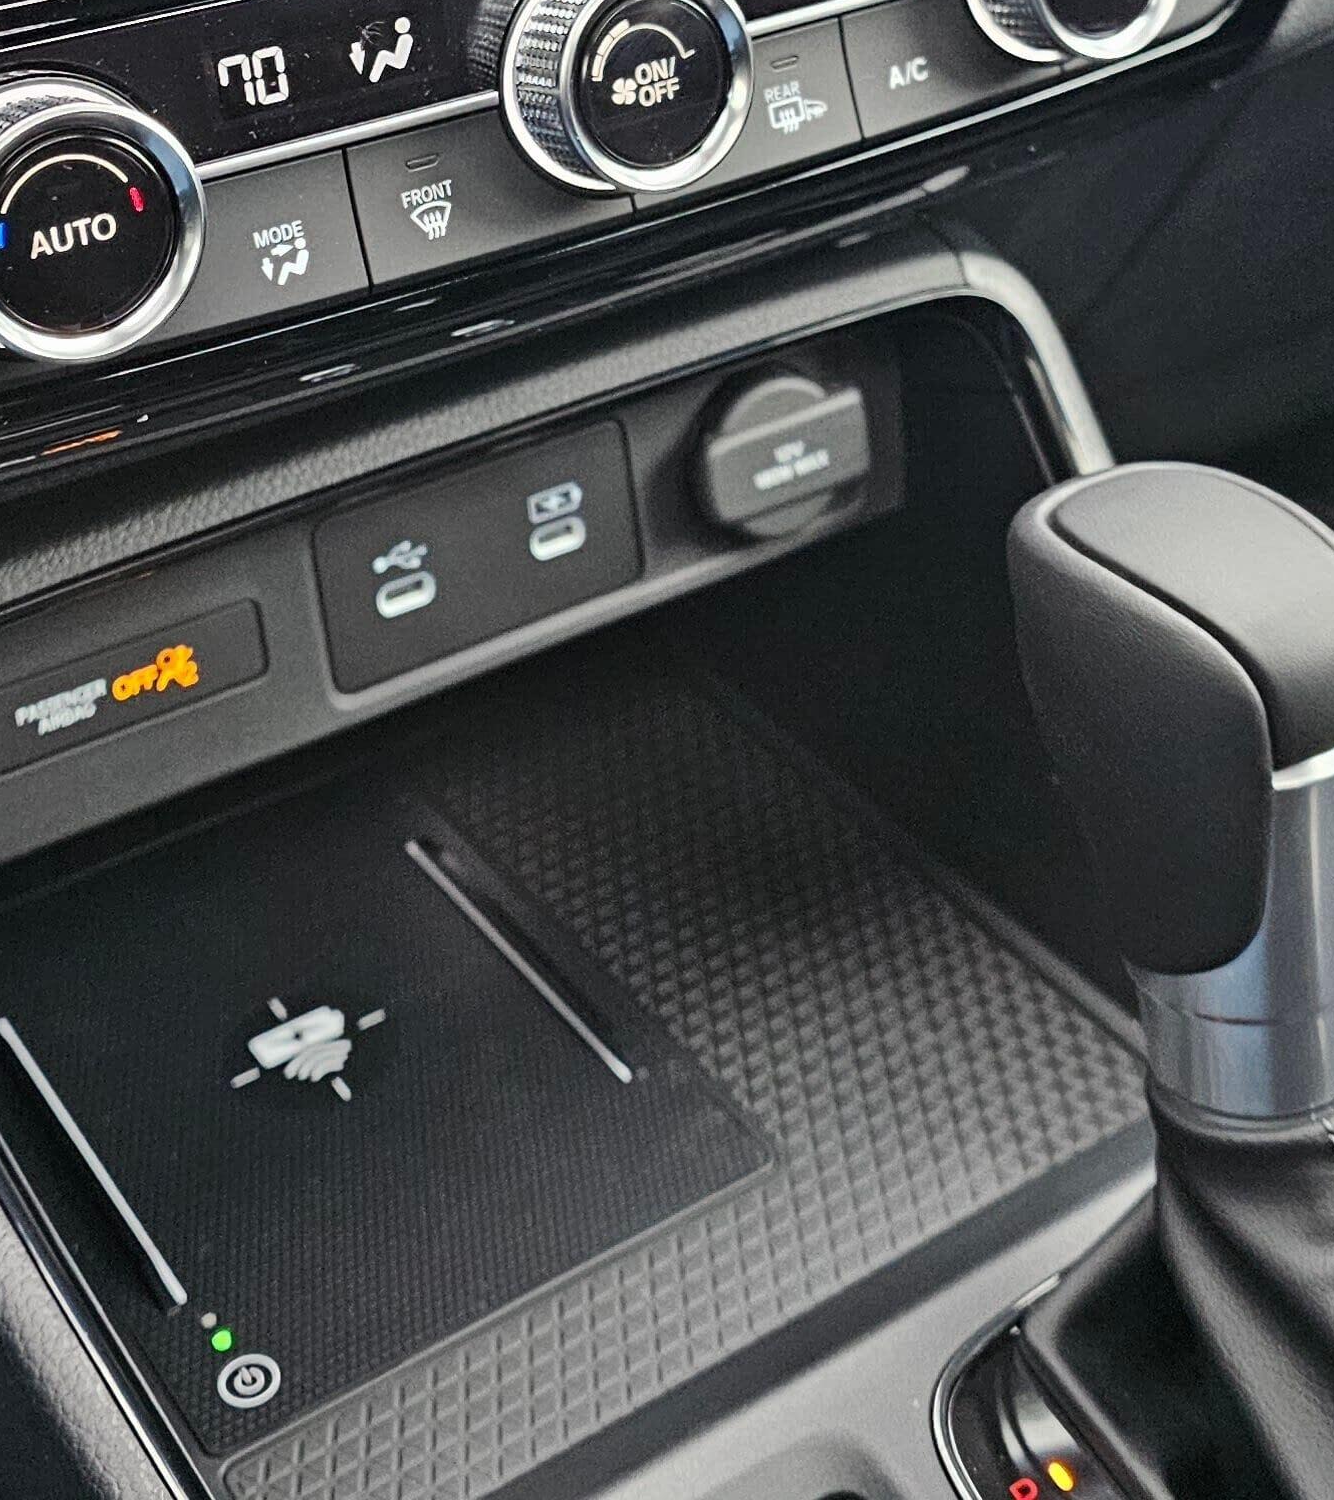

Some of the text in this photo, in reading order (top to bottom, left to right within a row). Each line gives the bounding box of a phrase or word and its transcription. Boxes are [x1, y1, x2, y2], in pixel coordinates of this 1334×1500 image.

[217, 45, 290, 106] 70
[634, 56, 676, 86] ON/
[888, 56, 929, 91] A/C
[637, 76, 680, 107] OFF
[763, 80, 801, 104] REAR
[401, 178, 453, 211] FRONT
[30, 211, 118, 260] AUTO
[252, 219, 305, 250] MODE
